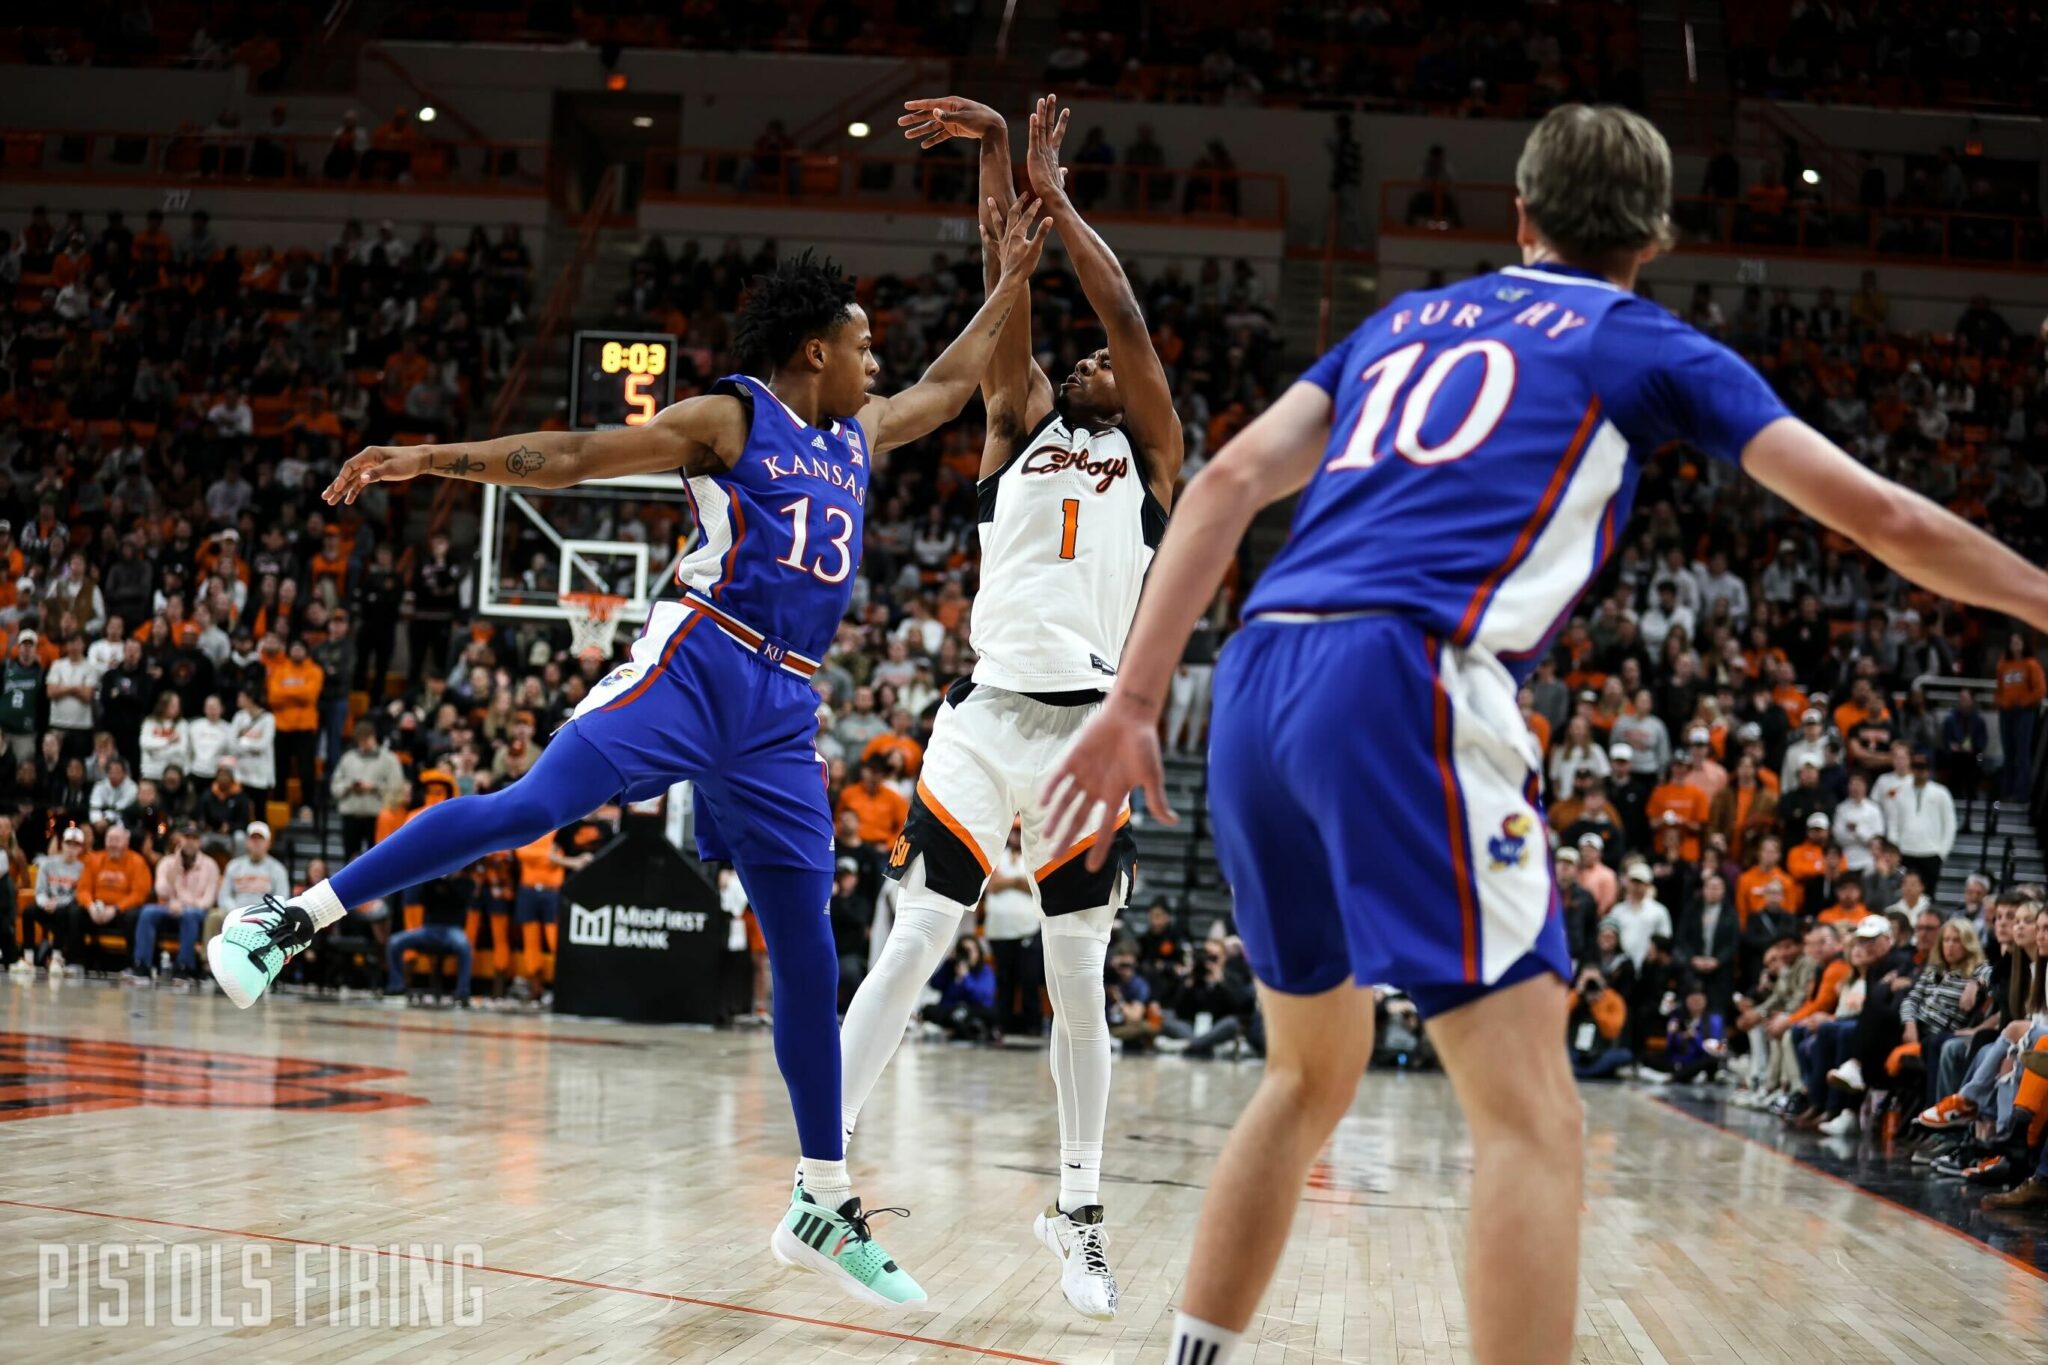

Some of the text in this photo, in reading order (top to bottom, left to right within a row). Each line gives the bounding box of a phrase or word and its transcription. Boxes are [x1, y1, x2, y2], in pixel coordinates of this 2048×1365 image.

[1391, 299, 1587, 339] FURHY
[601, 341, 667, 375] 8:03
[624, 373, 656, 427] 5
[1326, 338, 1518, 472] 10
[761, 454, 865, 507] KANSAS
[1021, 445, 1129, 494] Cowboys
[776, 496, 854, 584] 13
[1058, 498, 1080, 560] 1
[763, 642, 785, 662] KU
[612, 925, 670, 951] BANK
